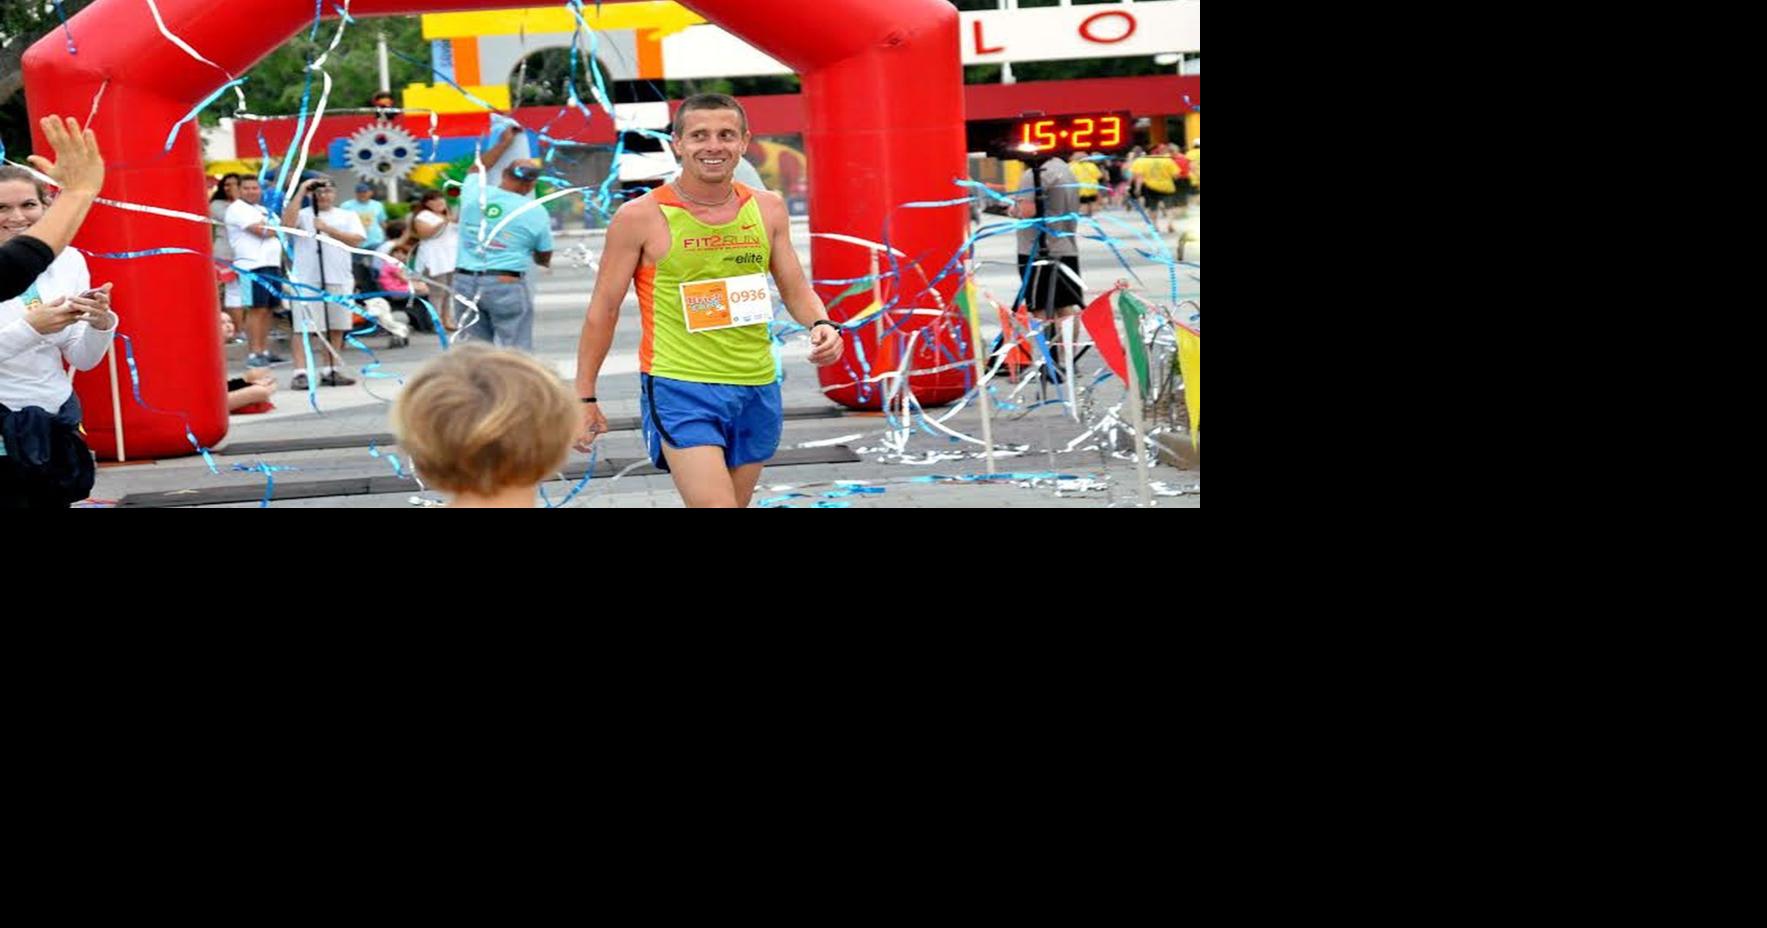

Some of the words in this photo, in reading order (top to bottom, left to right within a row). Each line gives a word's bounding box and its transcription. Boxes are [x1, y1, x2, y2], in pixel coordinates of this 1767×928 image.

[683, 235, 760, 249] FIT2RUN
[735, 252, 763, 264] elite
[730, 287, 766, 303] 0936
